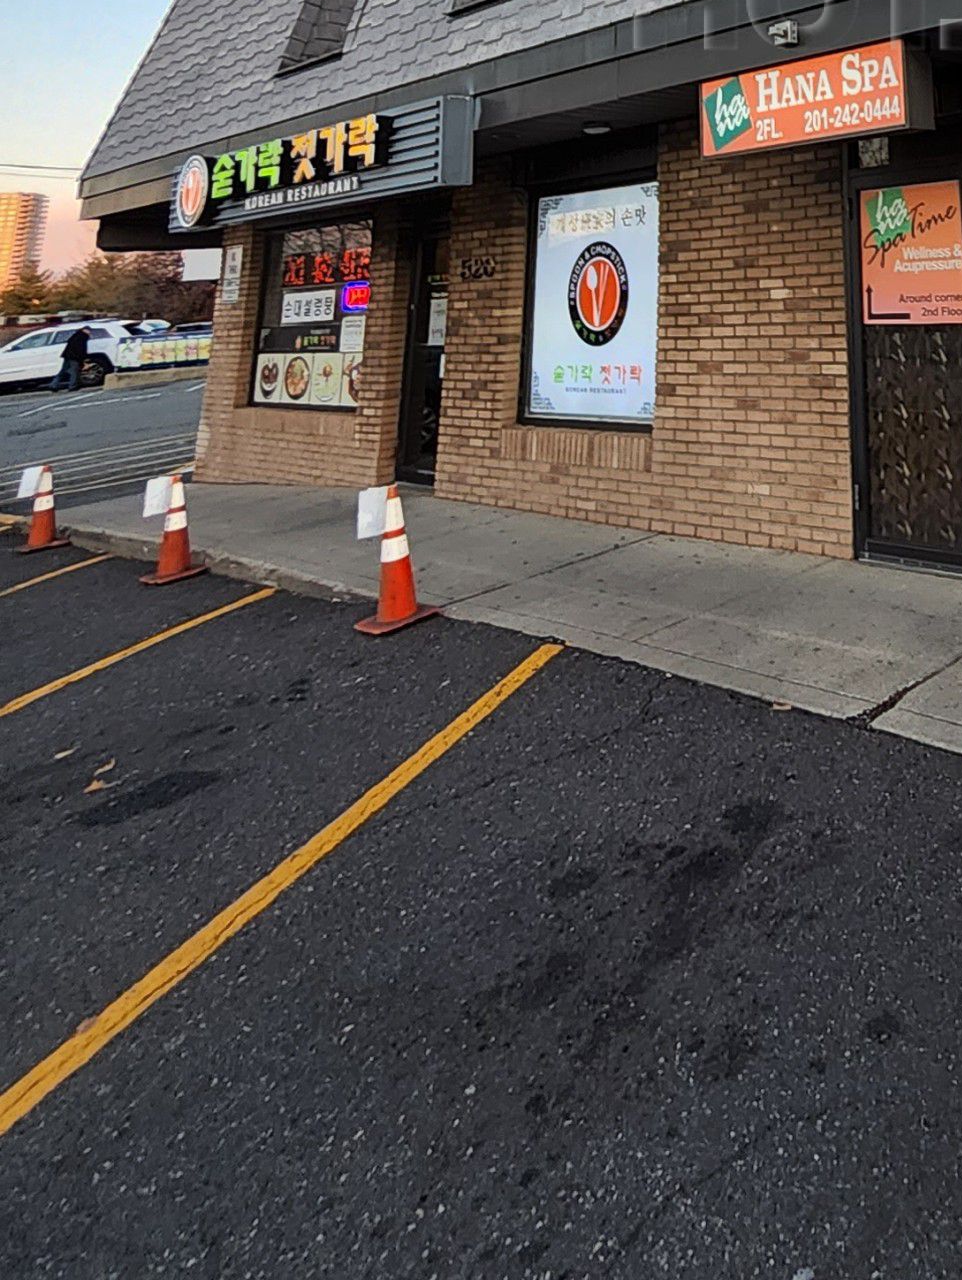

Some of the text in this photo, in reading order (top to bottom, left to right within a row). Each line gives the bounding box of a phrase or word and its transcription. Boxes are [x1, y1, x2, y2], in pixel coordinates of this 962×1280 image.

[755, 53, 899, 113] HANA SPA
[803, 95, 901, 134] 201-242-0444
[290, 113, 379, 184] 젓가락
[245, 176, 359, 211] KOREAN RESTAURANT
[864, 202, 957, 268] Spa Time
[903, 244, 962, 259] Wellness &
[590, 244, 628, 284] CHOPSTICK
[893, 258, 962, 274] Acupressure
[899, 293, 932, 303] Around
[921, 307, 939, 316] 2nd
